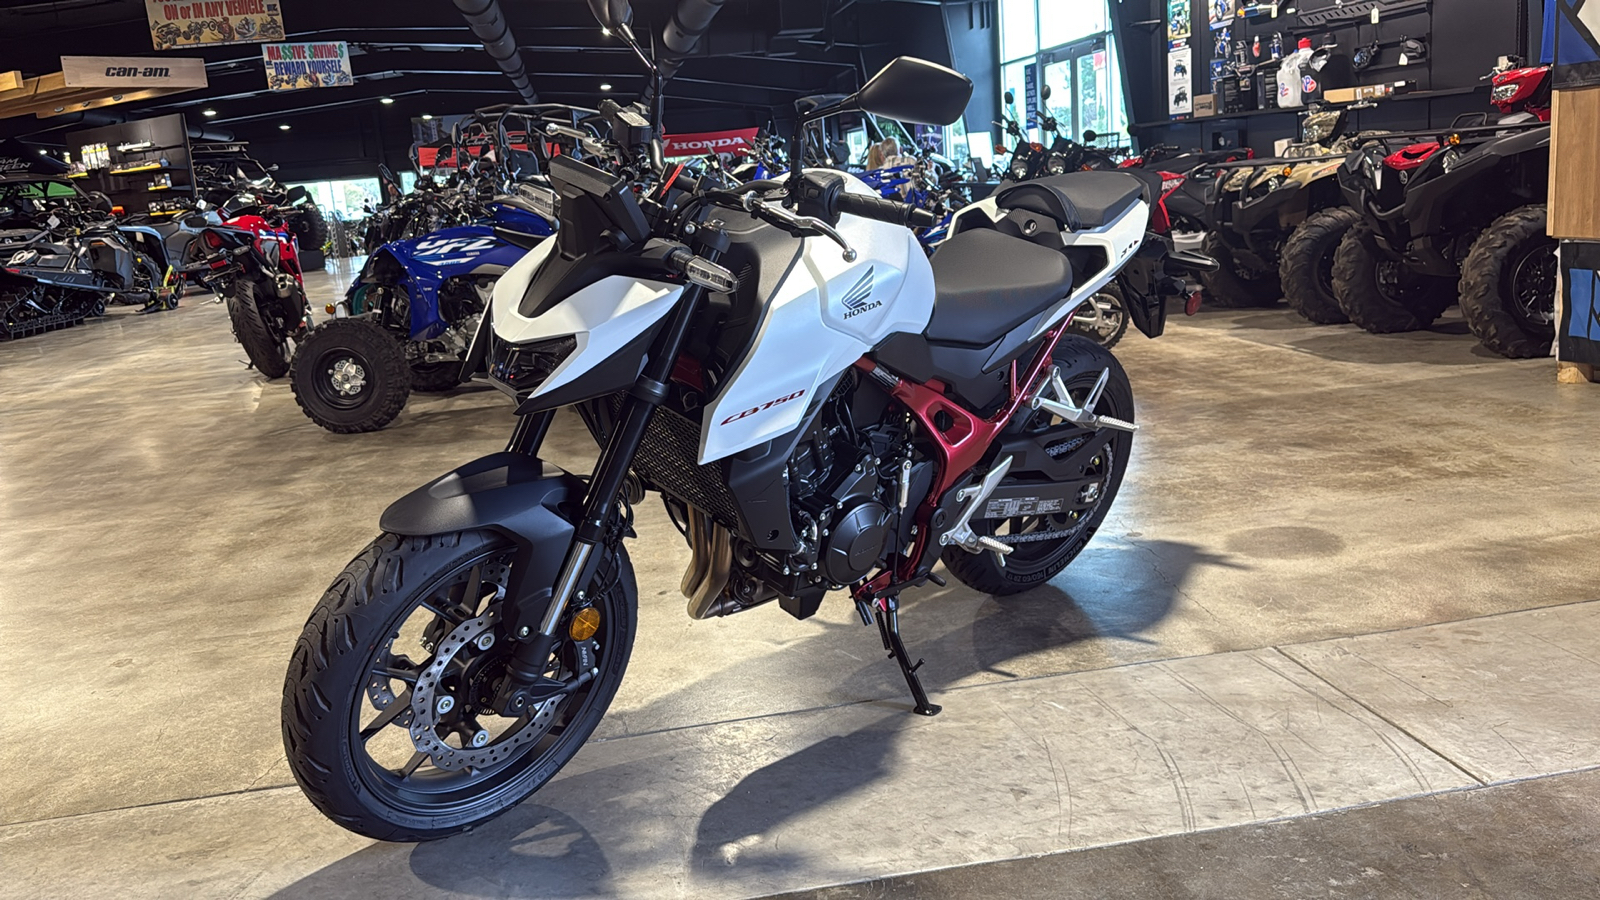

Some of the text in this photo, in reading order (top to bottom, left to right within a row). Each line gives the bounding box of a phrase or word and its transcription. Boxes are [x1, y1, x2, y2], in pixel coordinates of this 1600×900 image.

[164, 4, 179, 20] ON
[180, 6, 191, 19] or
[192, 2, 204, 18] IN
[205, 0, 225, 17] ANY
[225, 0, 265, 16] VEHICLE
[308, 43, 344, 60] $AVING$
[105, 67, 170, 77] can-am
[274, 61, 306, 76] REWARD
[307, 60, 342, 75] YOURSELF
[672, 137, 745, 150] HONDA
[843, 300, 882, 320] HONDA
[720, 389, 805, 426] CB750
